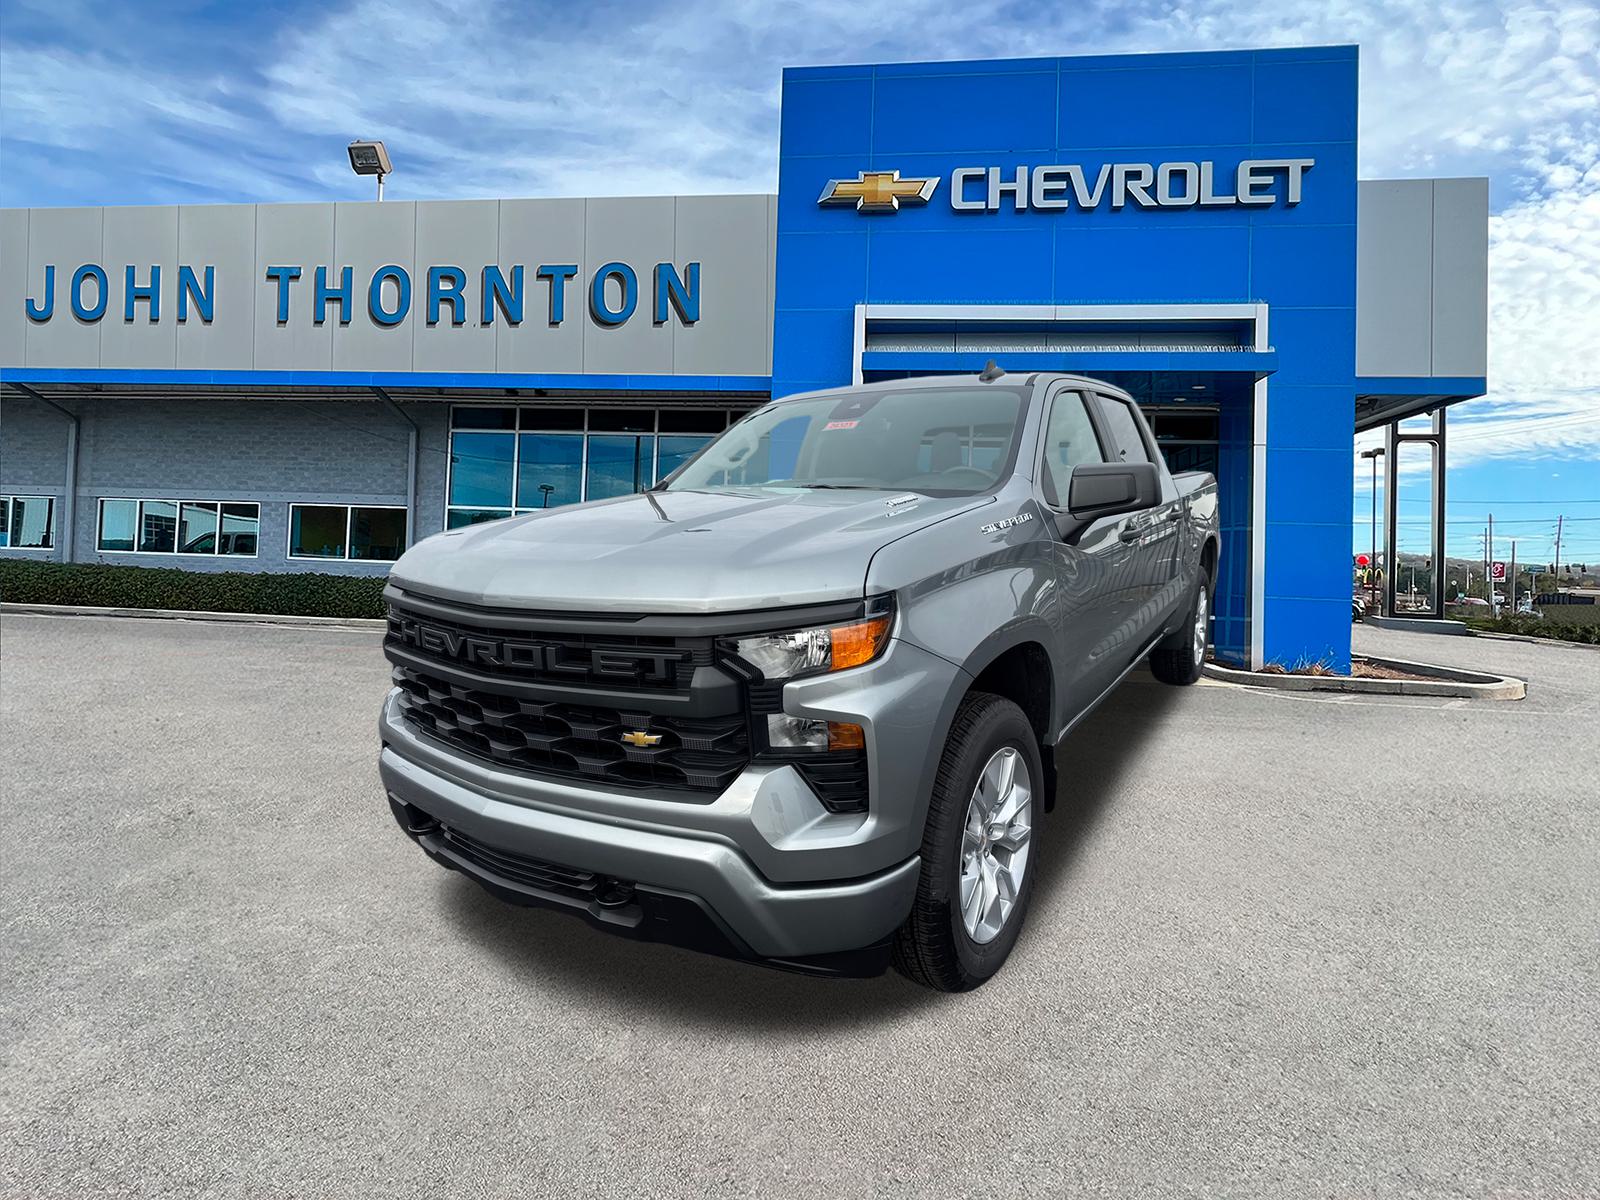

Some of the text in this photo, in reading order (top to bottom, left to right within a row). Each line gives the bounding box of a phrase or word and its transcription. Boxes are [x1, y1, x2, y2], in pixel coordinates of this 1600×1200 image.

[950, 158, 1316, 212] CHEVROLET
[25, 261, 702, 327] JOHN THORNTON
